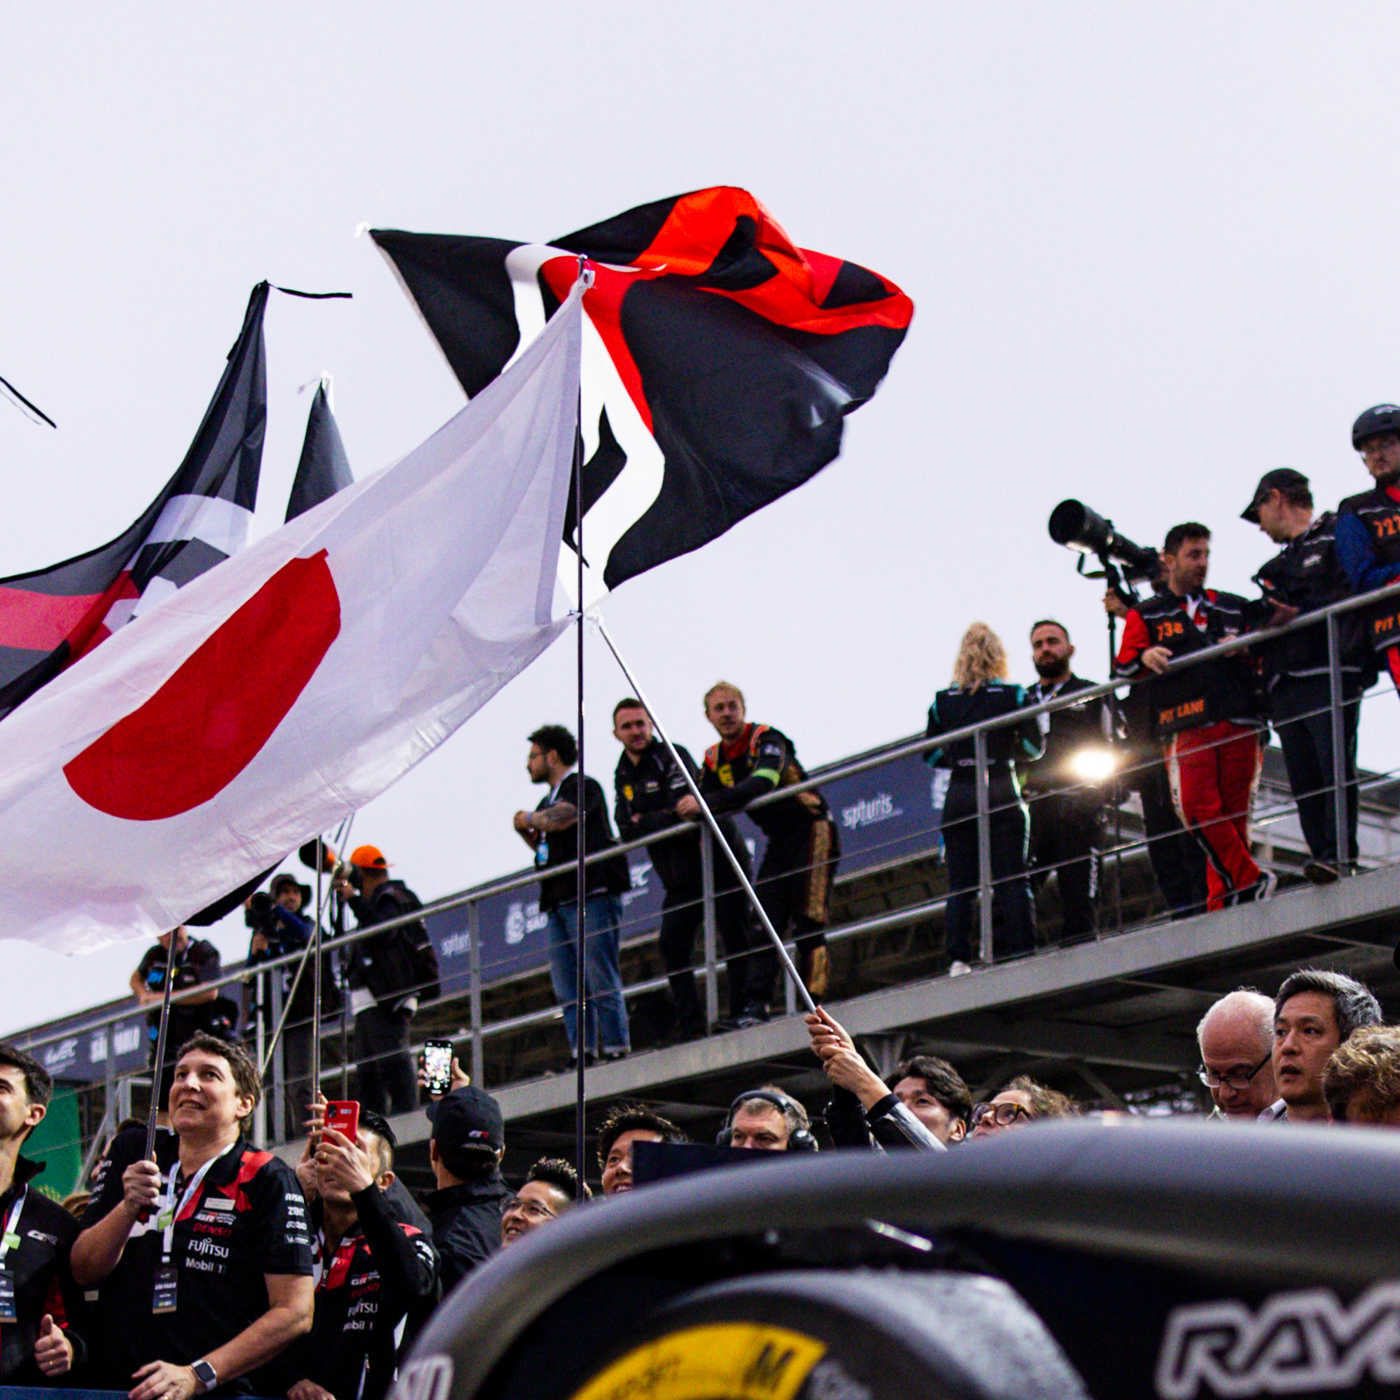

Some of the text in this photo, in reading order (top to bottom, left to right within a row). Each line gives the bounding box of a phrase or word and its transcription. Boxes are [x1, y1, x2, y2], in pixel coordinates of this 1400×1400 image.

[1373, 616, 1394, 634] PIT
[187, 1237, 230, 1259] FUJITSU
[185, 1257, 214, 1272] Mobil
